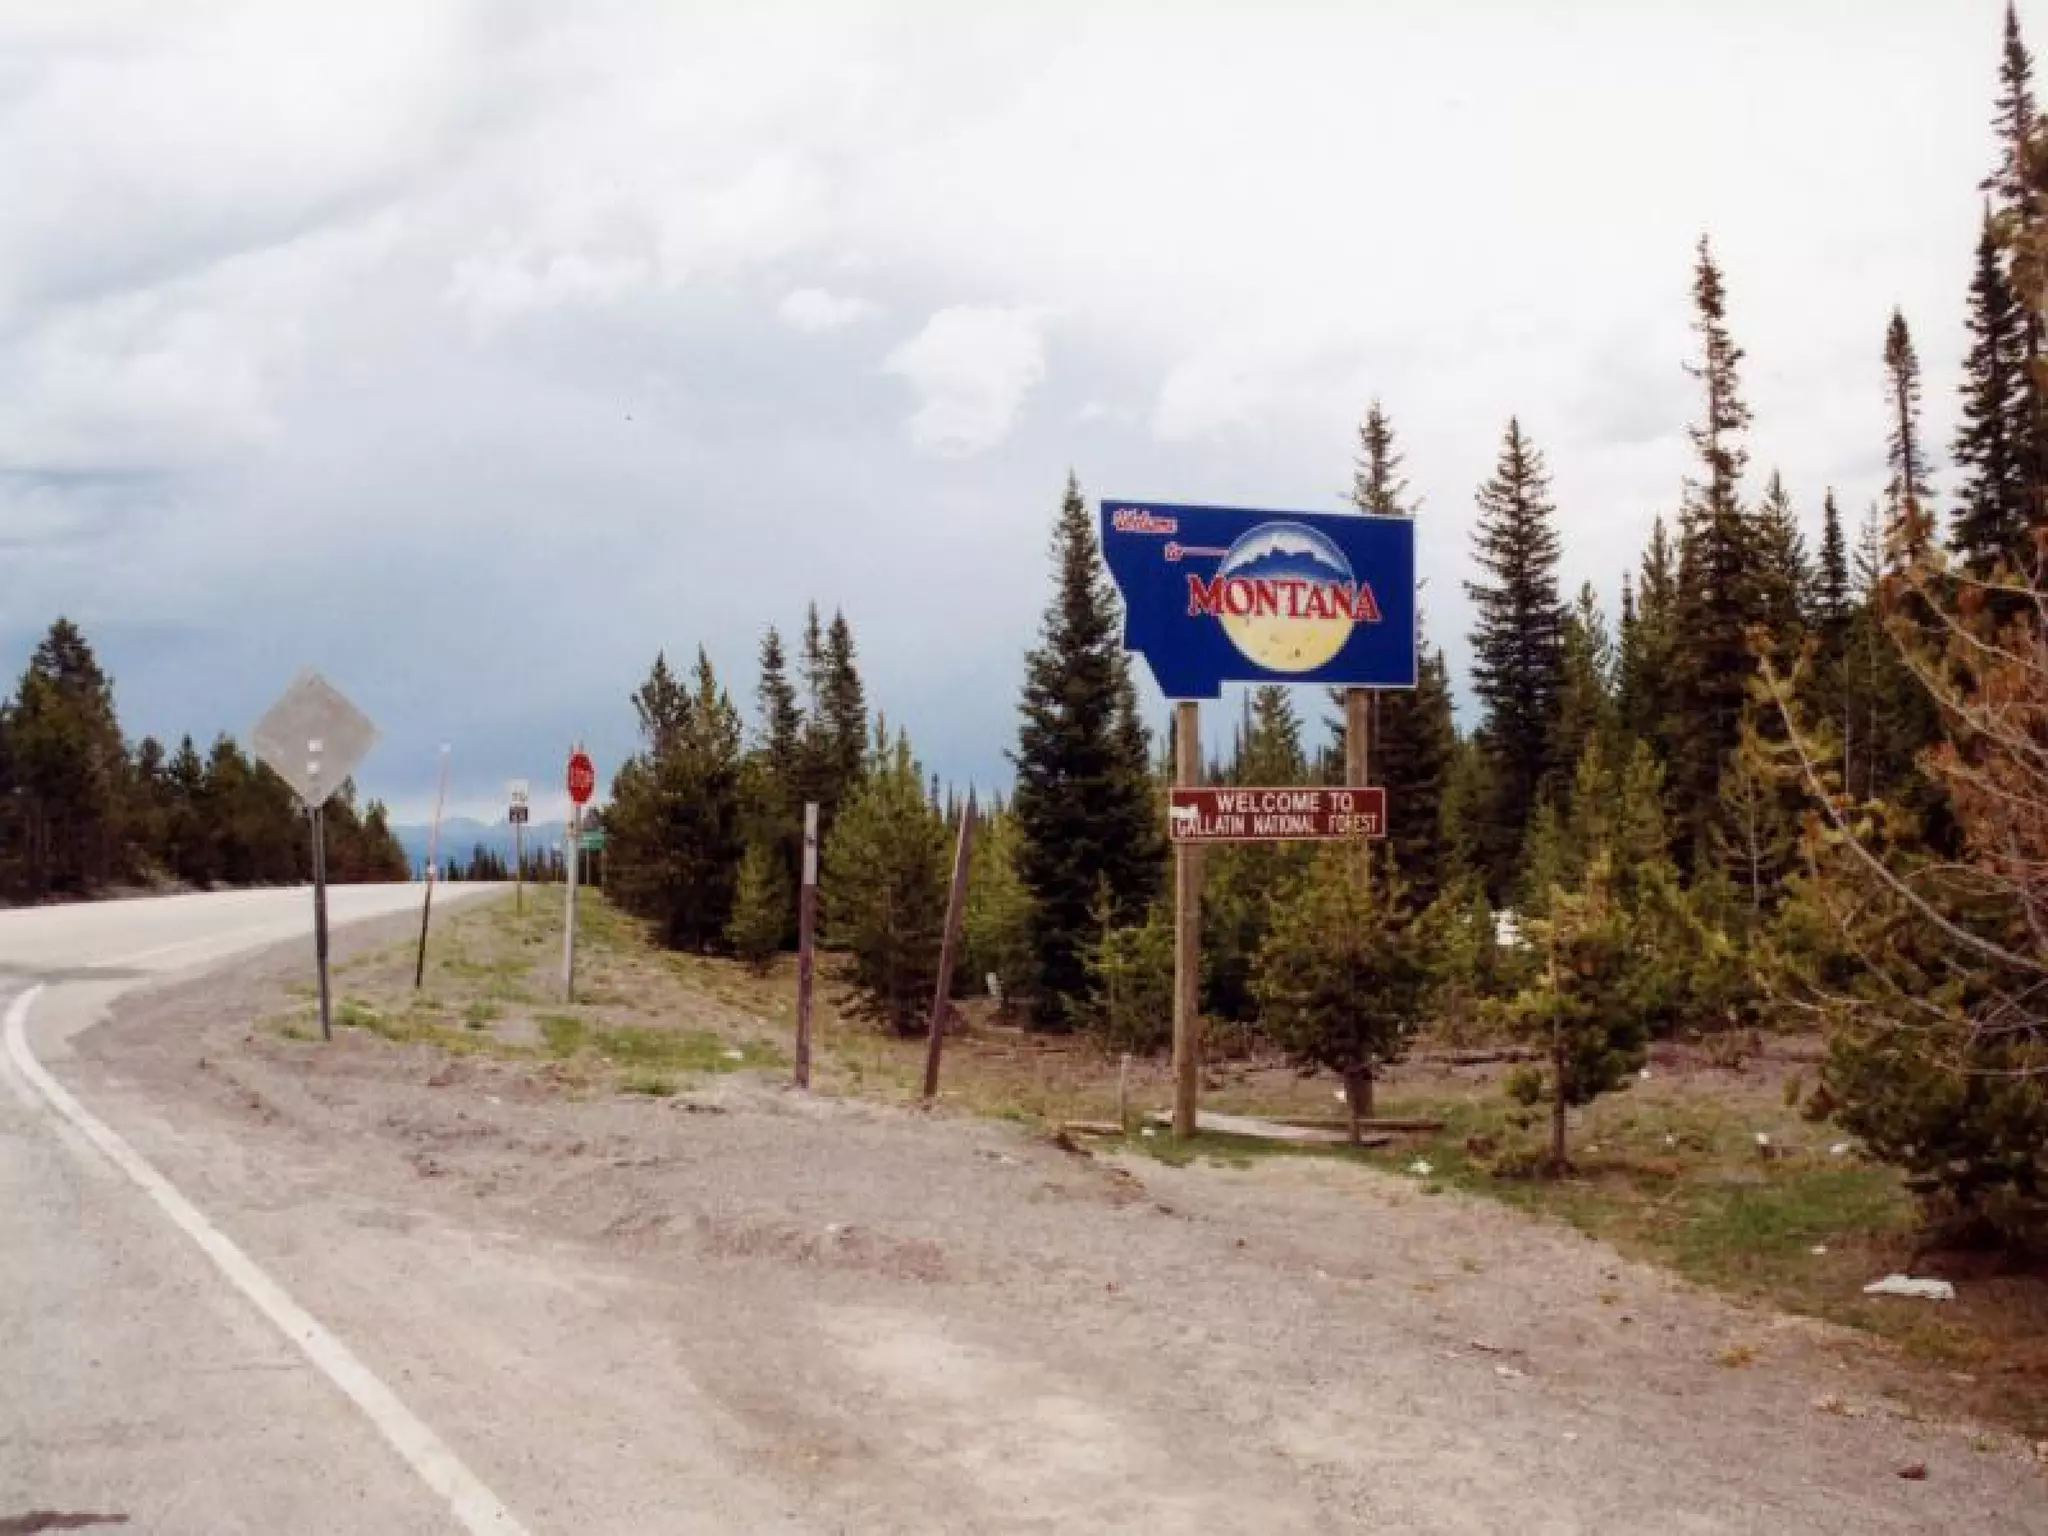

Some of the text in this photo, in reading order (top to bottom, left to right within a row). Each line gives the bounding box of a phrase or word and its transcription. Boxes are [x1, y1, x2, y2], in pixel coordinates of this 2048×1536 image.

[1187, 574, 1382, 622] MONTANA
[1216, 792, 1353, 812] WELCOME TO
[1254, 814, 1317, 835] NATIONAL
